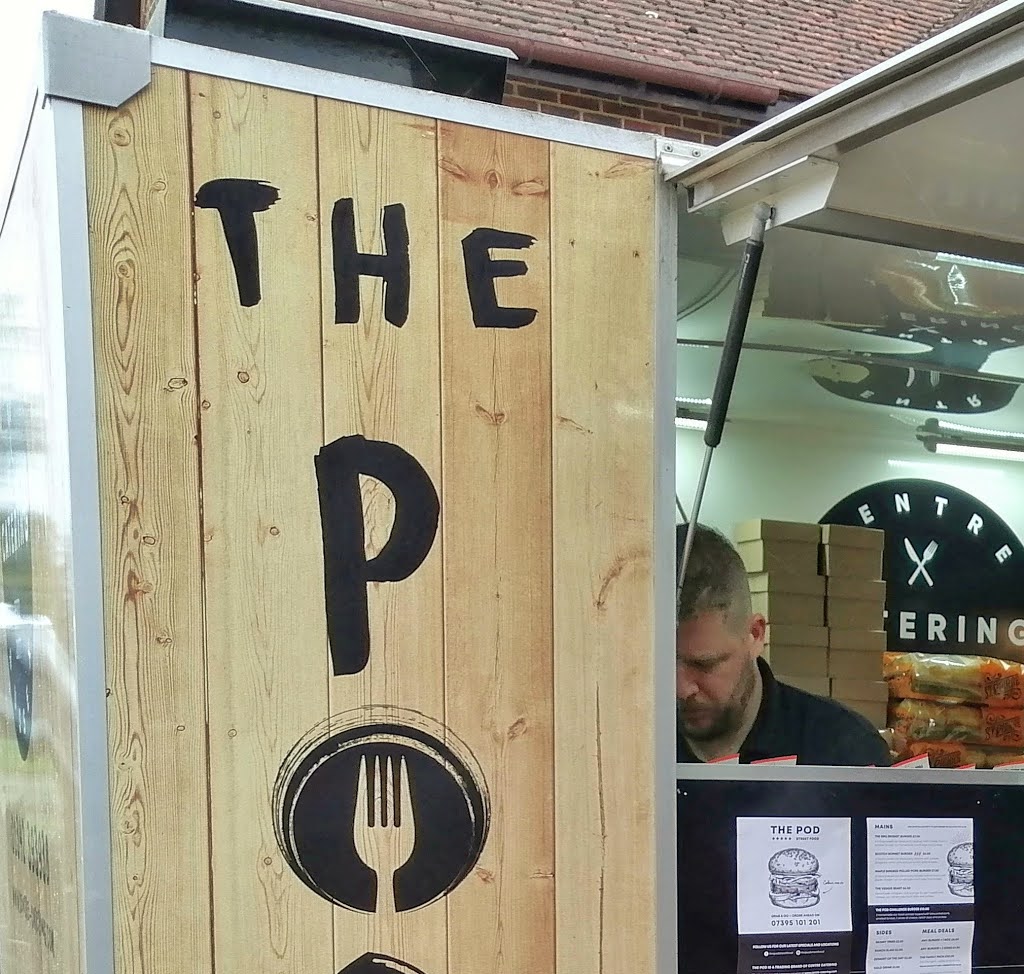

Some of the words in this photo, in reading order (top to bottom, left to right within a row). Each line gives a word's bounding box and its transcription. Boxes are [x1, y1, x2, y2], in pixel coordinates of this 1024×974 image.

[195, 177, 539, 329] THE
[858, 492, 1013, 563] ENTRE
[770, 825, 792, 834] THE
[796, 825, 820, 834] POD
